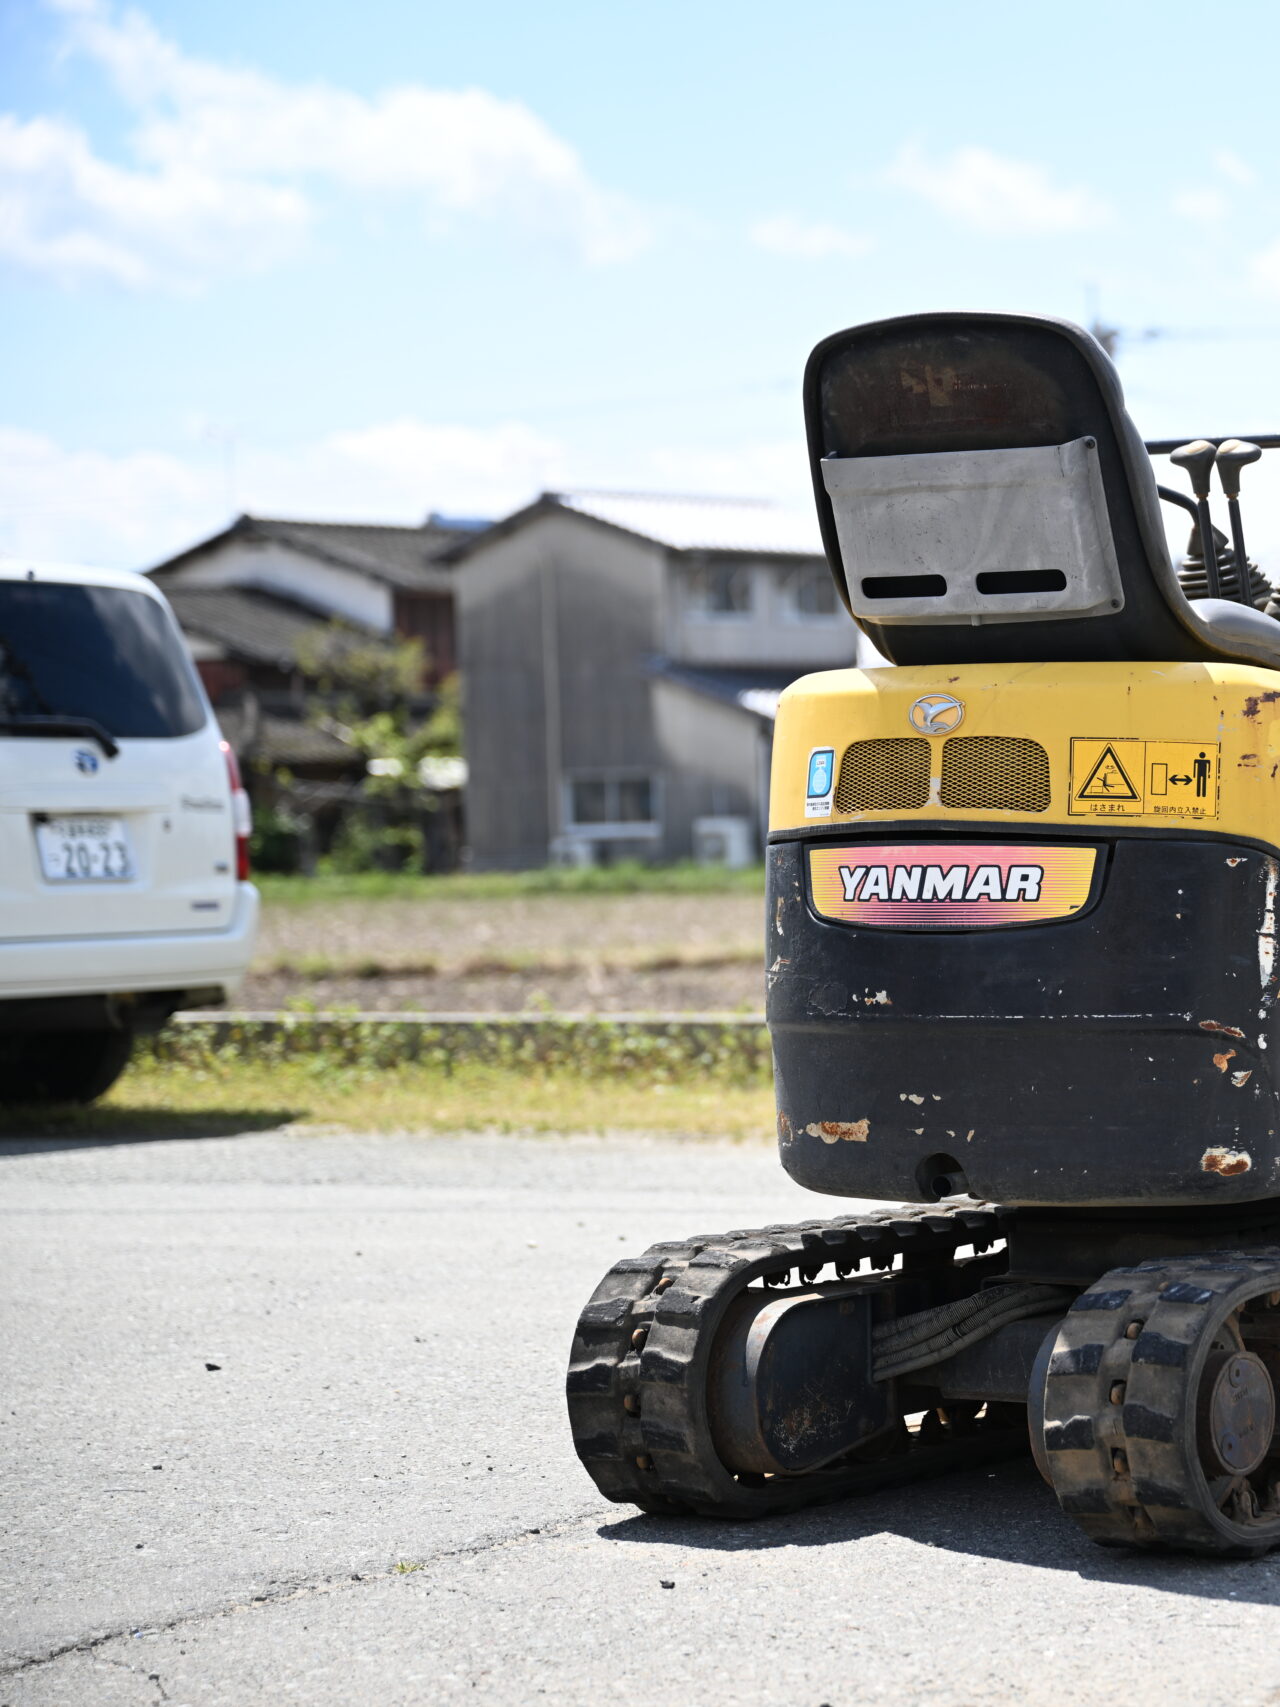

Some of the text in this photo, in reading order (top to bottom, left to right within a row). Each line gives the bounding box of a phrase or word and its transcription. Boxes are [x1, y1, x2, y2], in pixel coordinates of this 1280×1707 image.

[1090, 803, 1126, 812] はさまれ
[1153, 805, 1207, 815] 旋回内立入禁止
[839, 865, 1044, 902] YANMAR
